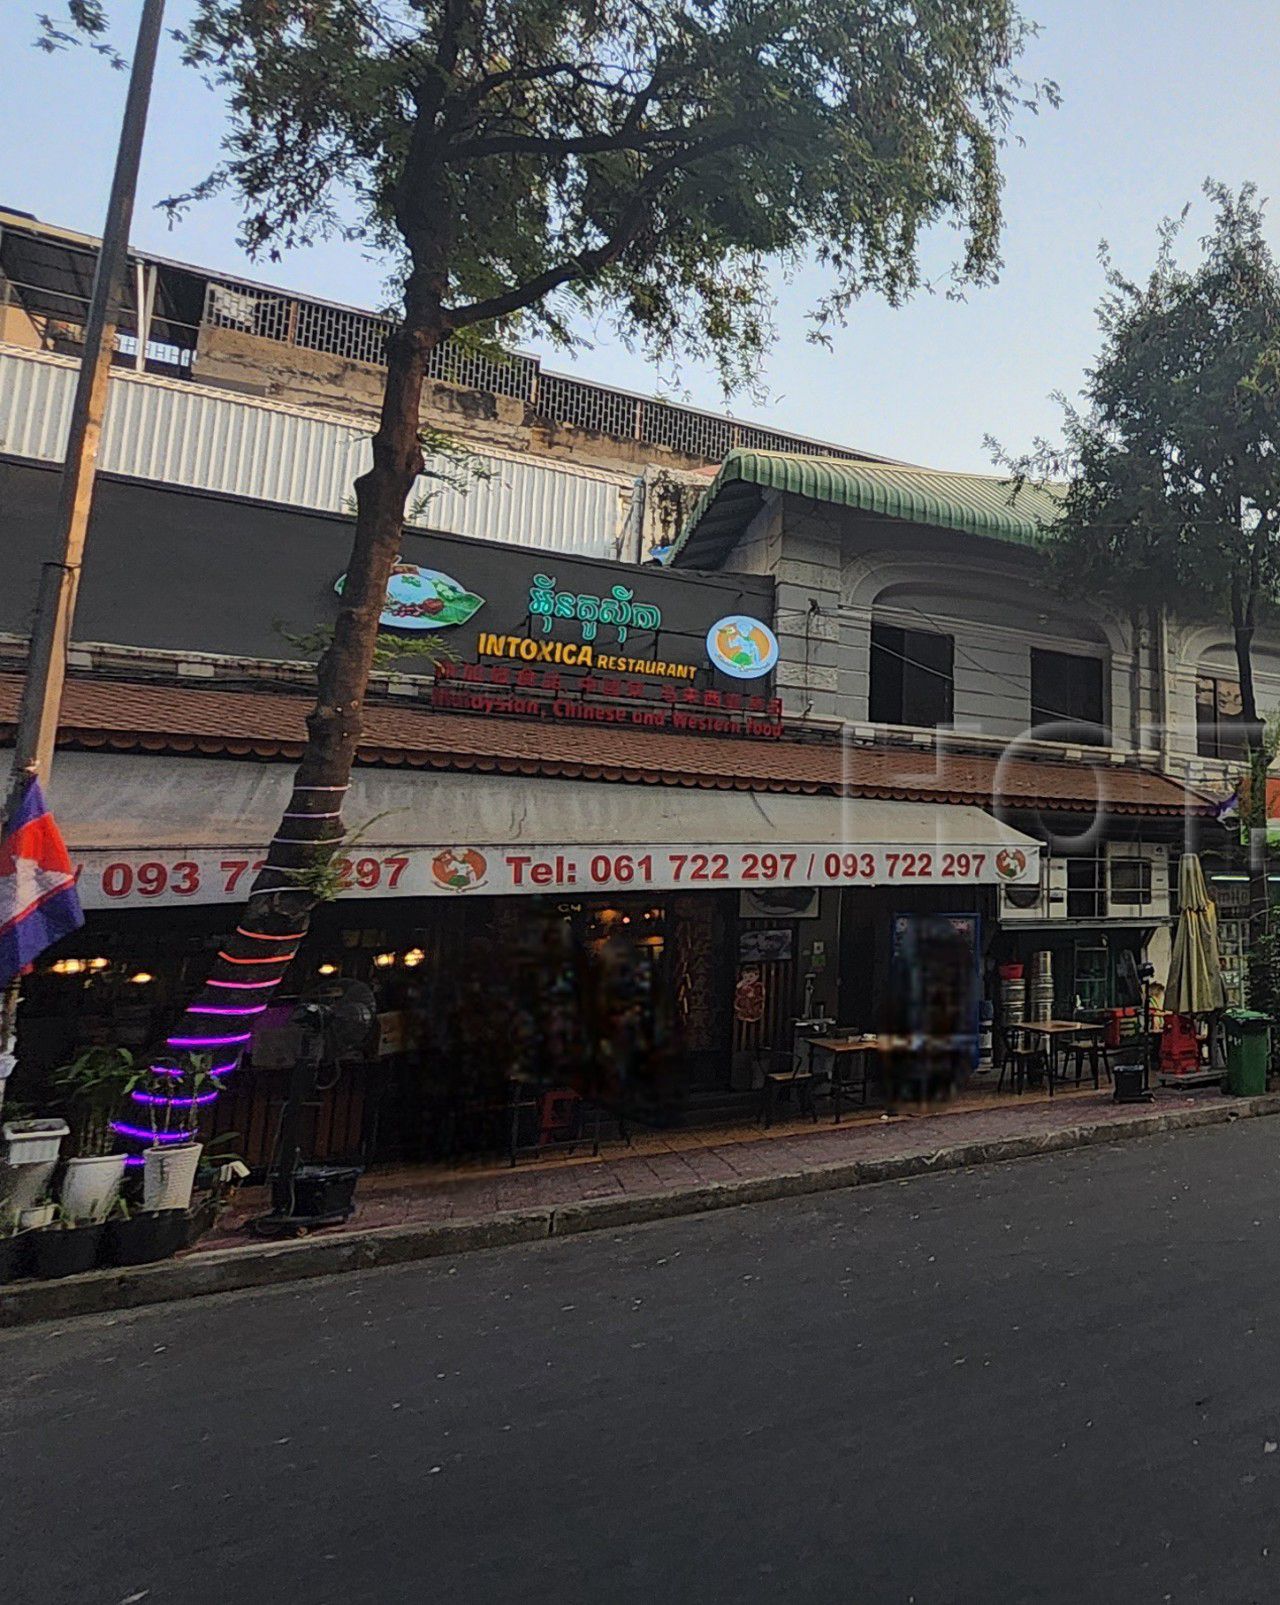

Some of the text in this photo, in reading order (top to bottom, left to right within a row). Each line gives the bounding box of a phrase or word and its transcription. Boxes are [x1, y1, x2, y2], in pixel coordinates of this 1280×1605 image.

[478, 632, 593, 667] INTOXICA
[597, 654, 698, 680] RESTAURANT
[552, 698, 627, 721] Chinese
[631, 708, 666, 727] and
[671, 710, 741, 734] Western
[102, 860, 201, 898] 093
[506, 852, 987, 885] Tel: 061 722 297 / 093 722 297
